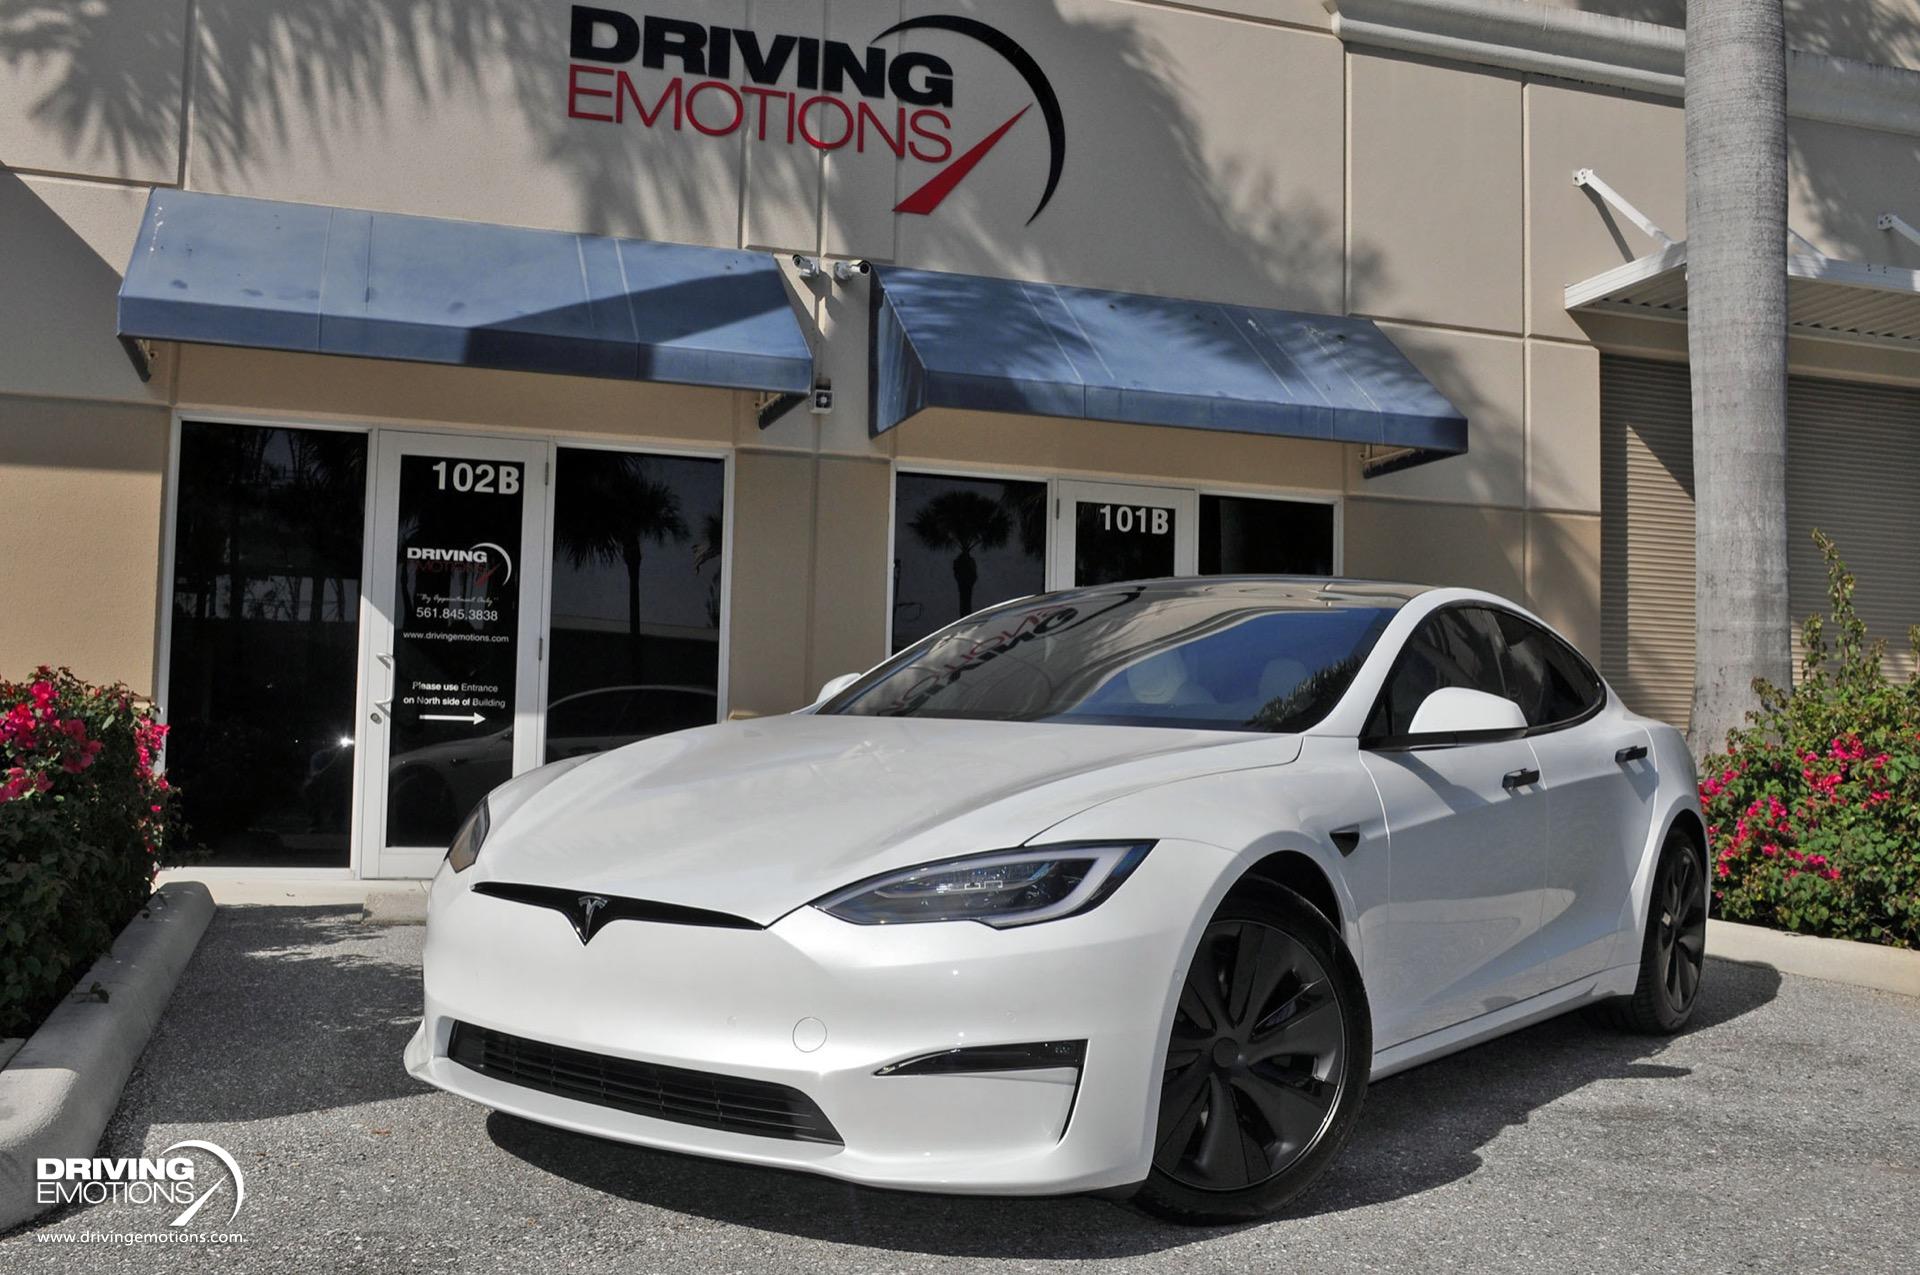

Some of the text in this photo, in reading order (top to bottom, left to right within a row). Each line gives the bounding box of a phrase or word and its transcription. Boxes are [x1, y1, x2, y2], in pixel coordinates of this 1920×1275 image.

[570, 4, 954, 108] DRIVING
[568, 64, 953, 163] EMOTIONS
[432, 461, 520, 495] 102B
[1100, 504, 1169, 535] 101B
[406, 547, 487, 563] DRIVING
[416, 606, 498, 621] 561.845.3838
[403, 631, 509, 643] www.drivingemotions.com
[412, 681, 498, 693] Please use Entrance
[403, 696, 506, 709] on North side of Building
